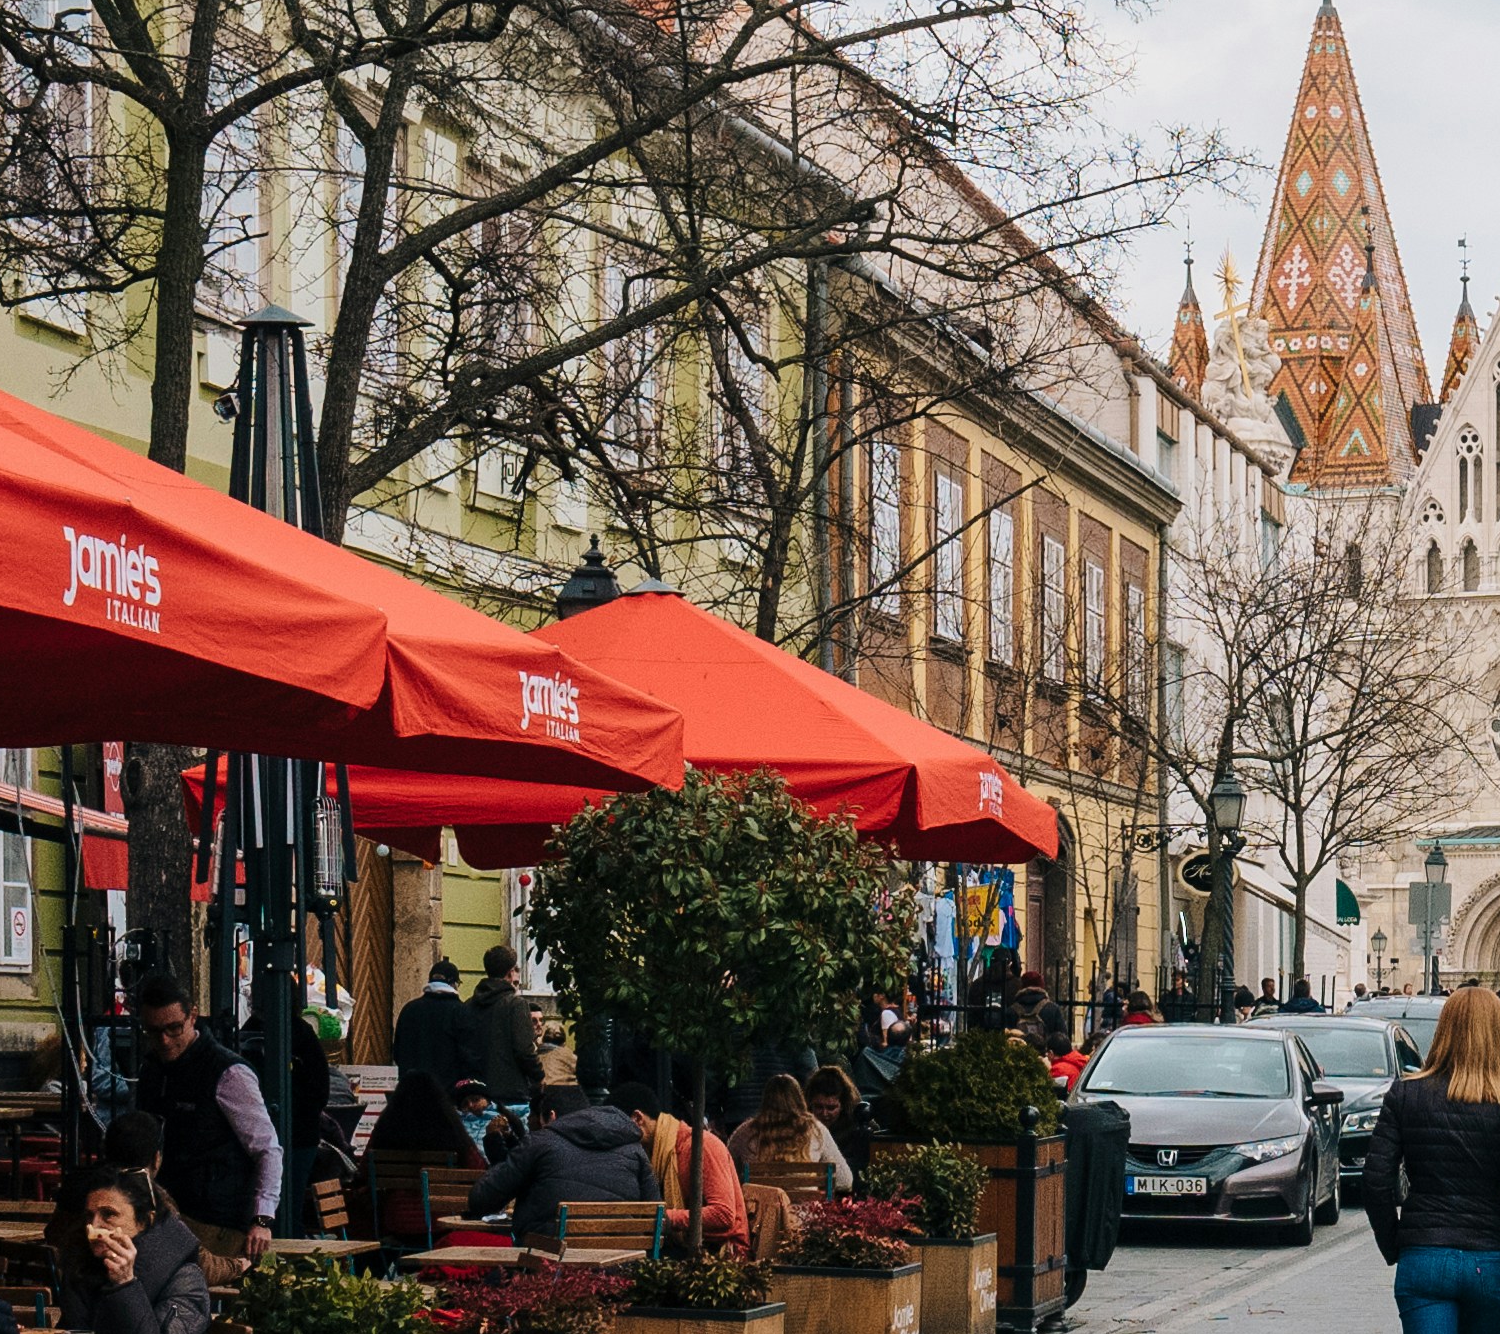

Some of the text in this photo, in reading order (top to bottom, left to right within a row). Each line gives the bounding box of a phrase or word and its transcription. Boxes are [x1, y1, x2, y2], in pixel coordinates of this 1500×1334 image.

[63, 526, 161, 606] Jamie's
[106, 598, 160, 634] ITALIAN
[518, 671, 580, 731] Jamie's
[546, 719, 580, 744] ITALIAN
[1137, 1178, 1203, 1193] MIK-036
[891, 1299, 914, 1331] Jamie
